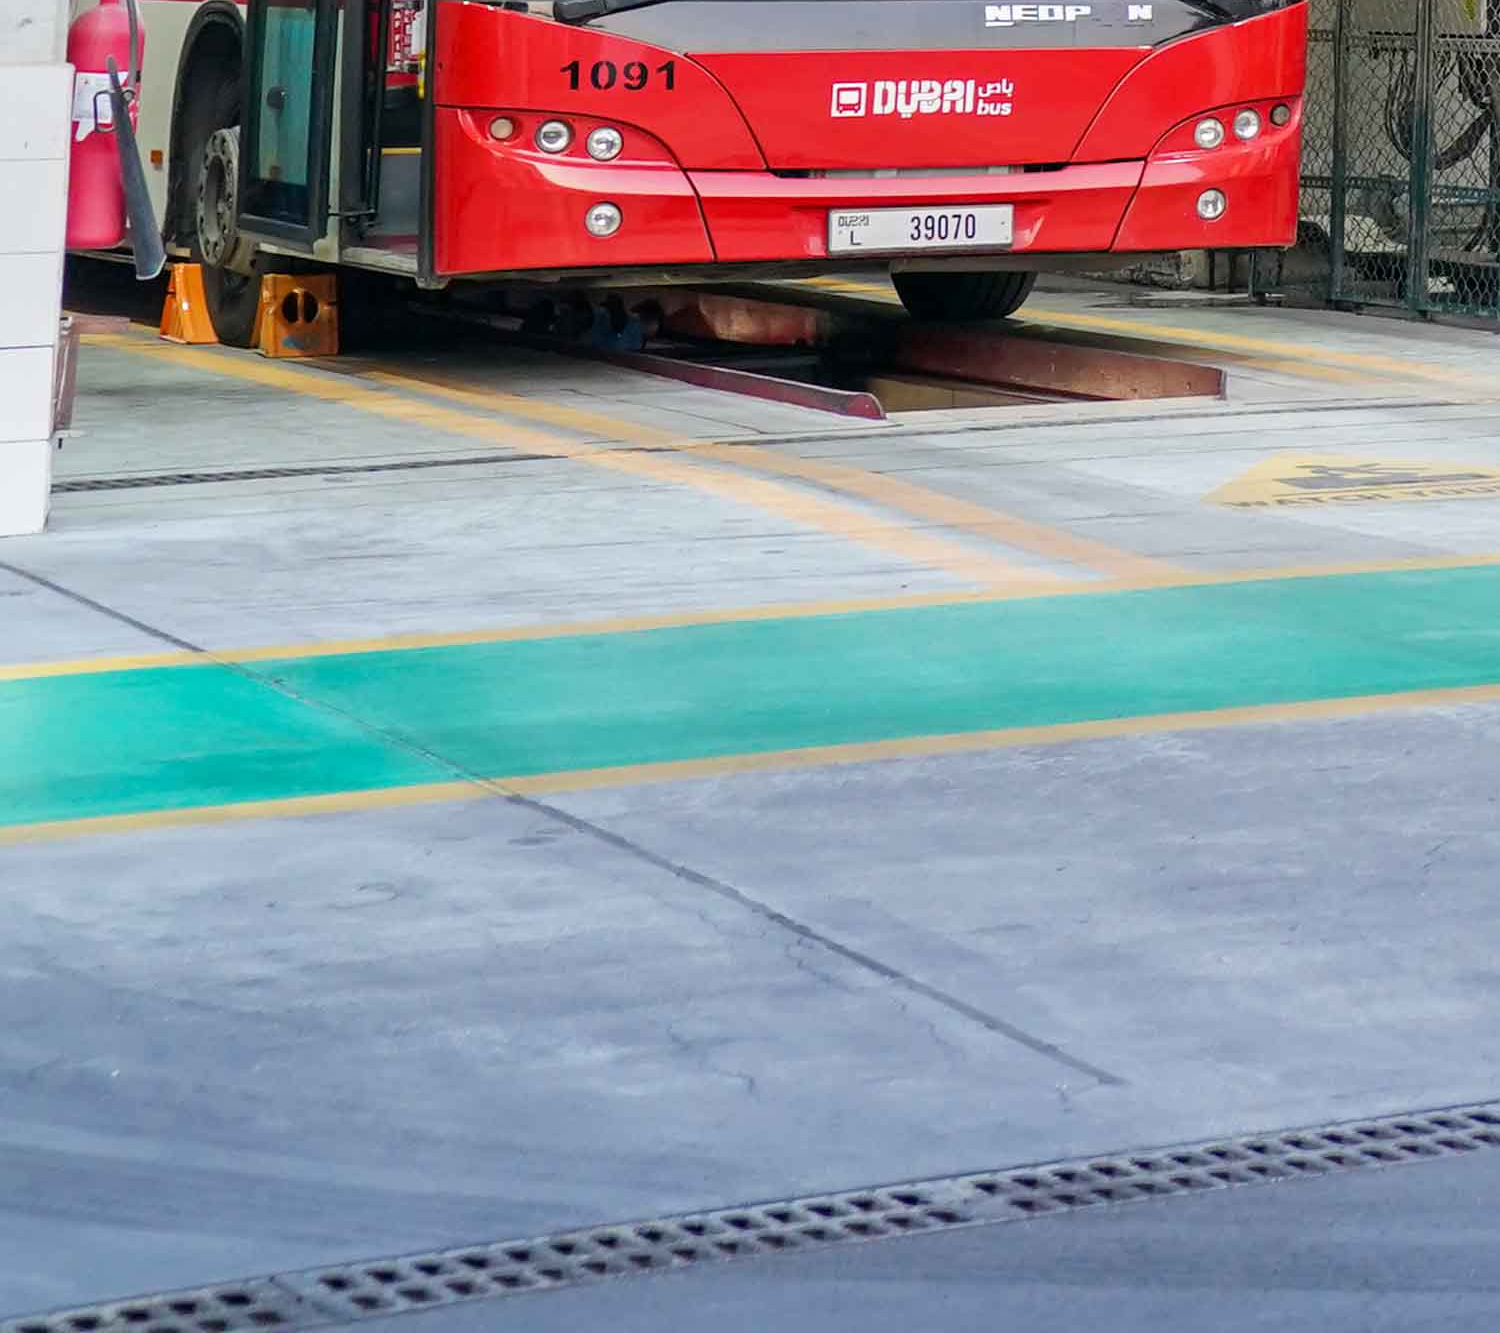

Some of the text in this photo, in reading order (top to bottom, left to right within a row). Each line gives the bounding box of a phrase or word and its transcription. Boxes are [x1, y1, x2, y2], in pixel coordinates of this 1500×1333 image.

[560, 60, 677, 91] 1091
[872, 79, 976, 118] DUBAI
[976, 101, 1012, 116] bus
[850, 230, 862, 245] L
[910, 213, 977, 241] 39070
